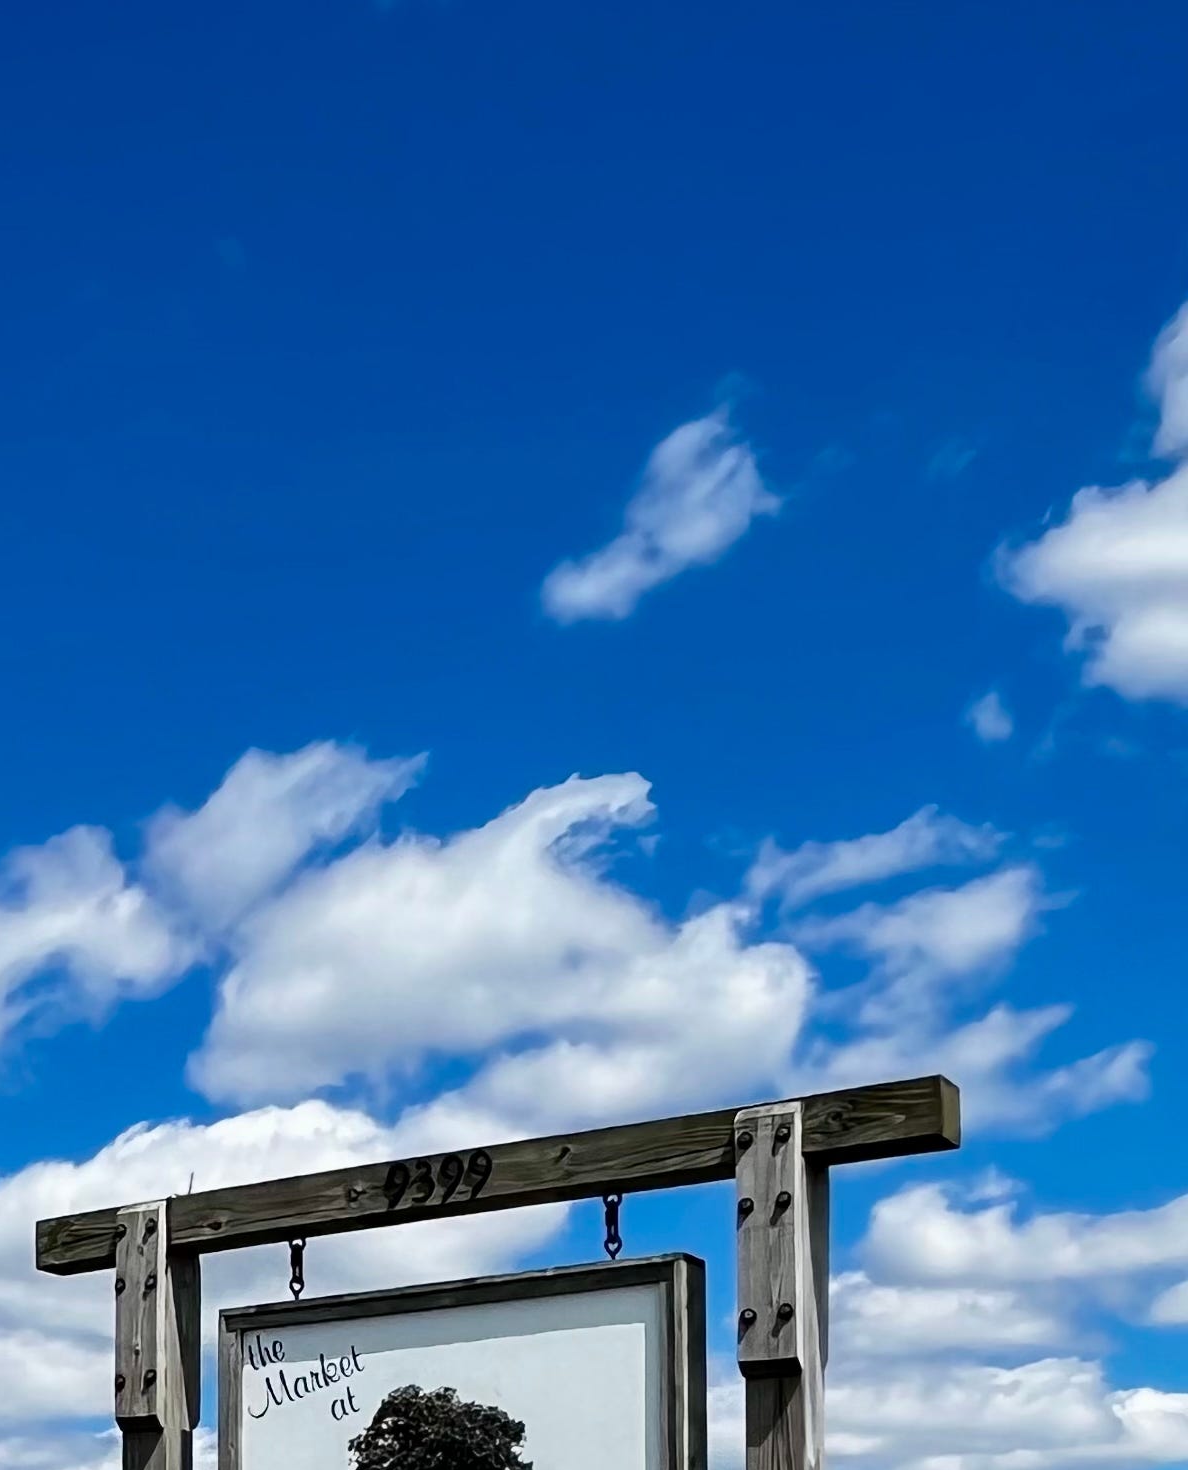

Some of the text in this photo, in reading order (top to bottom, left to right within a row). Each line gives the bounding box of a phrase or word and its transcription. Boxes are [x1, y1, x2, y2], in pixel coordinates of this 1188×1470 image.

[383, 1149, 492, 1209] 9399
[248, 1334, 285, 1370] the
[248, 1345, 365, 1418] Market
[331, 1386, 360, 1420] at
